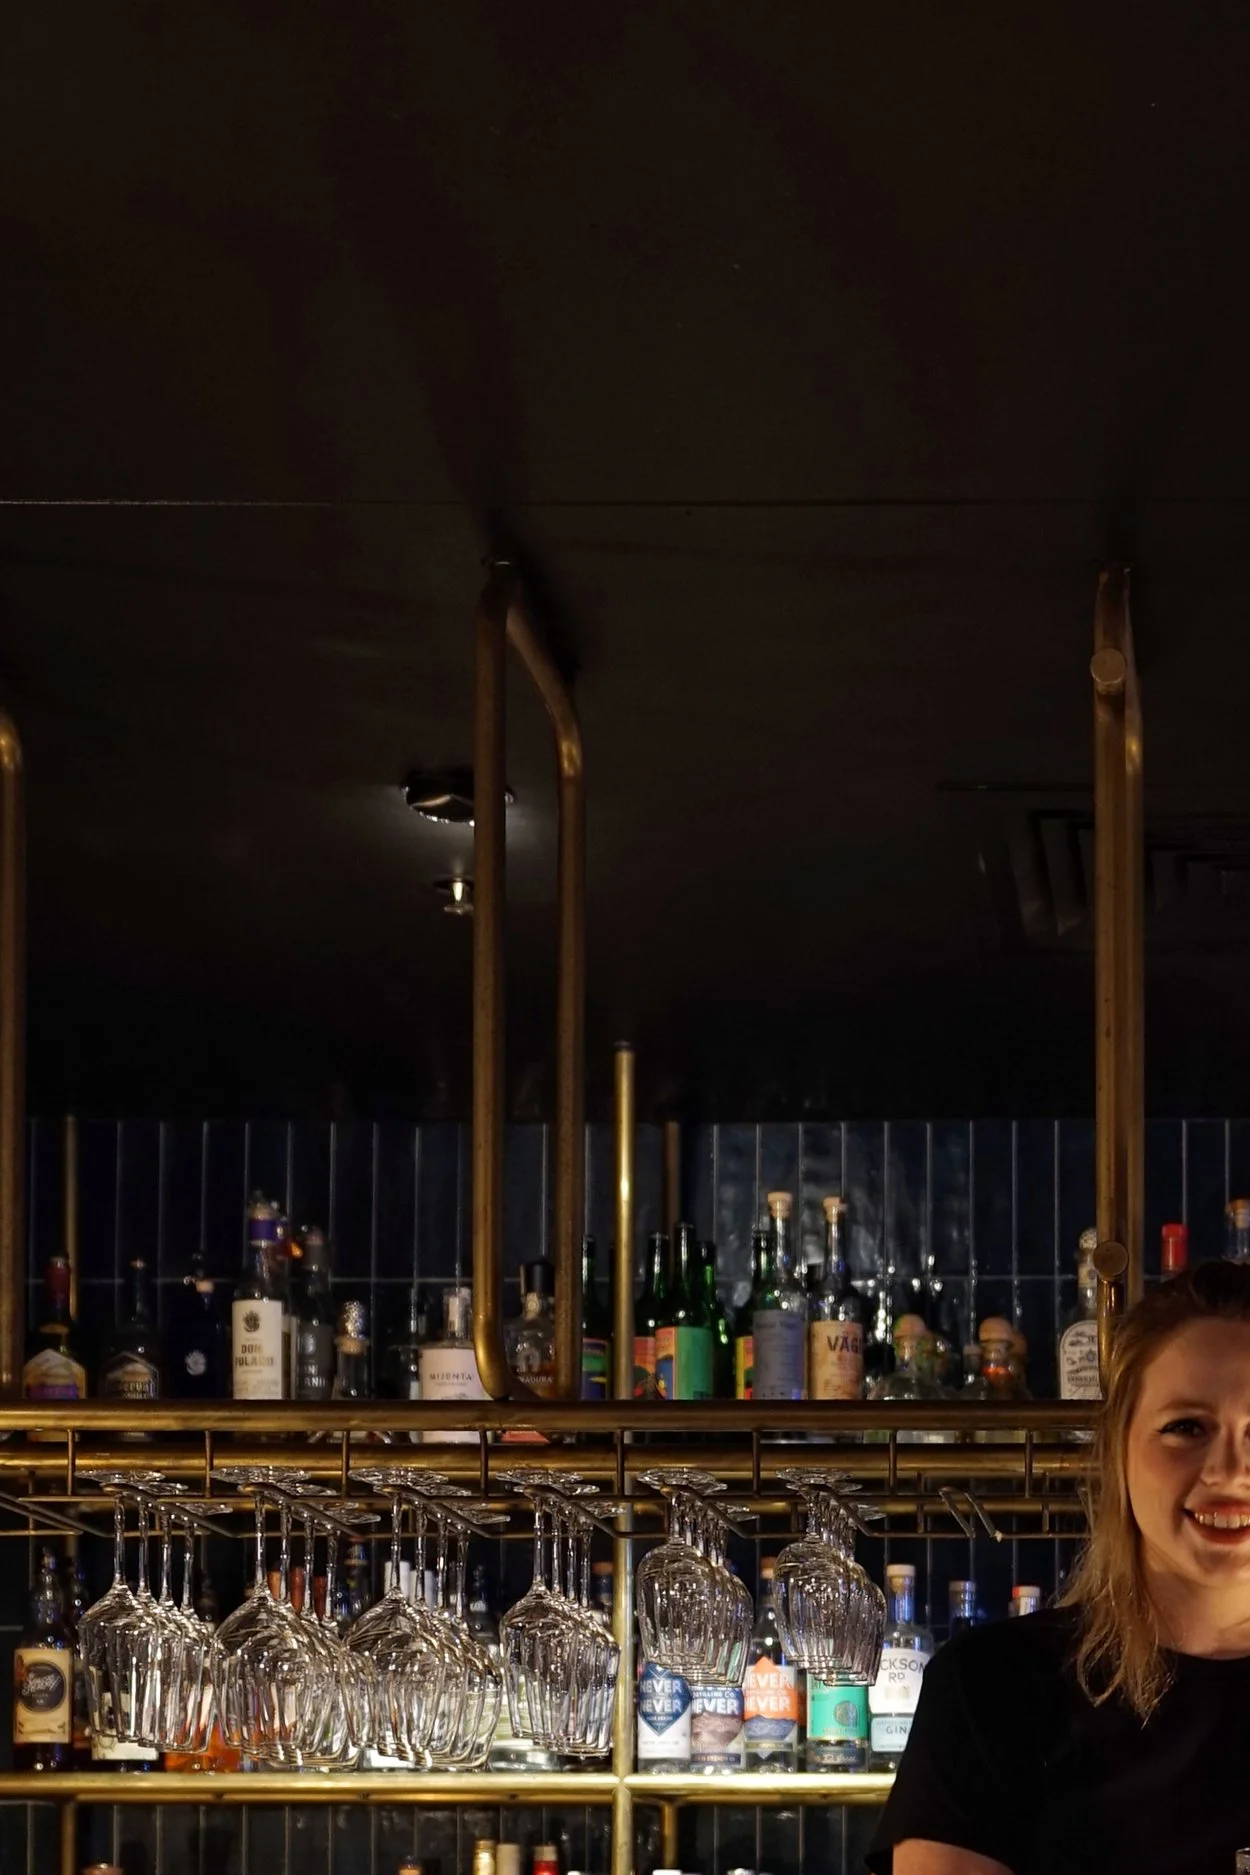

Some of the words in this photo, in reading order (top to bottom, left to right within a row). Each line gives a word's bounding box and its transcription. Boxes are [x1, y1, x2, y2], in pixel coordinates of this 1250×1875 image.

[429, 1371, 473, 1381] MIJENTA
[640, 1678, 683, 1693] NEVER
[744, 1672, 793, 1689] NEVER
[639, 1698, 683, 1713] NEVER
[691, 1698, 738, 1714] NEVER
[743, 1696, 792, 1712] NEVER
[886, 1726, 907, 1735] GIN
